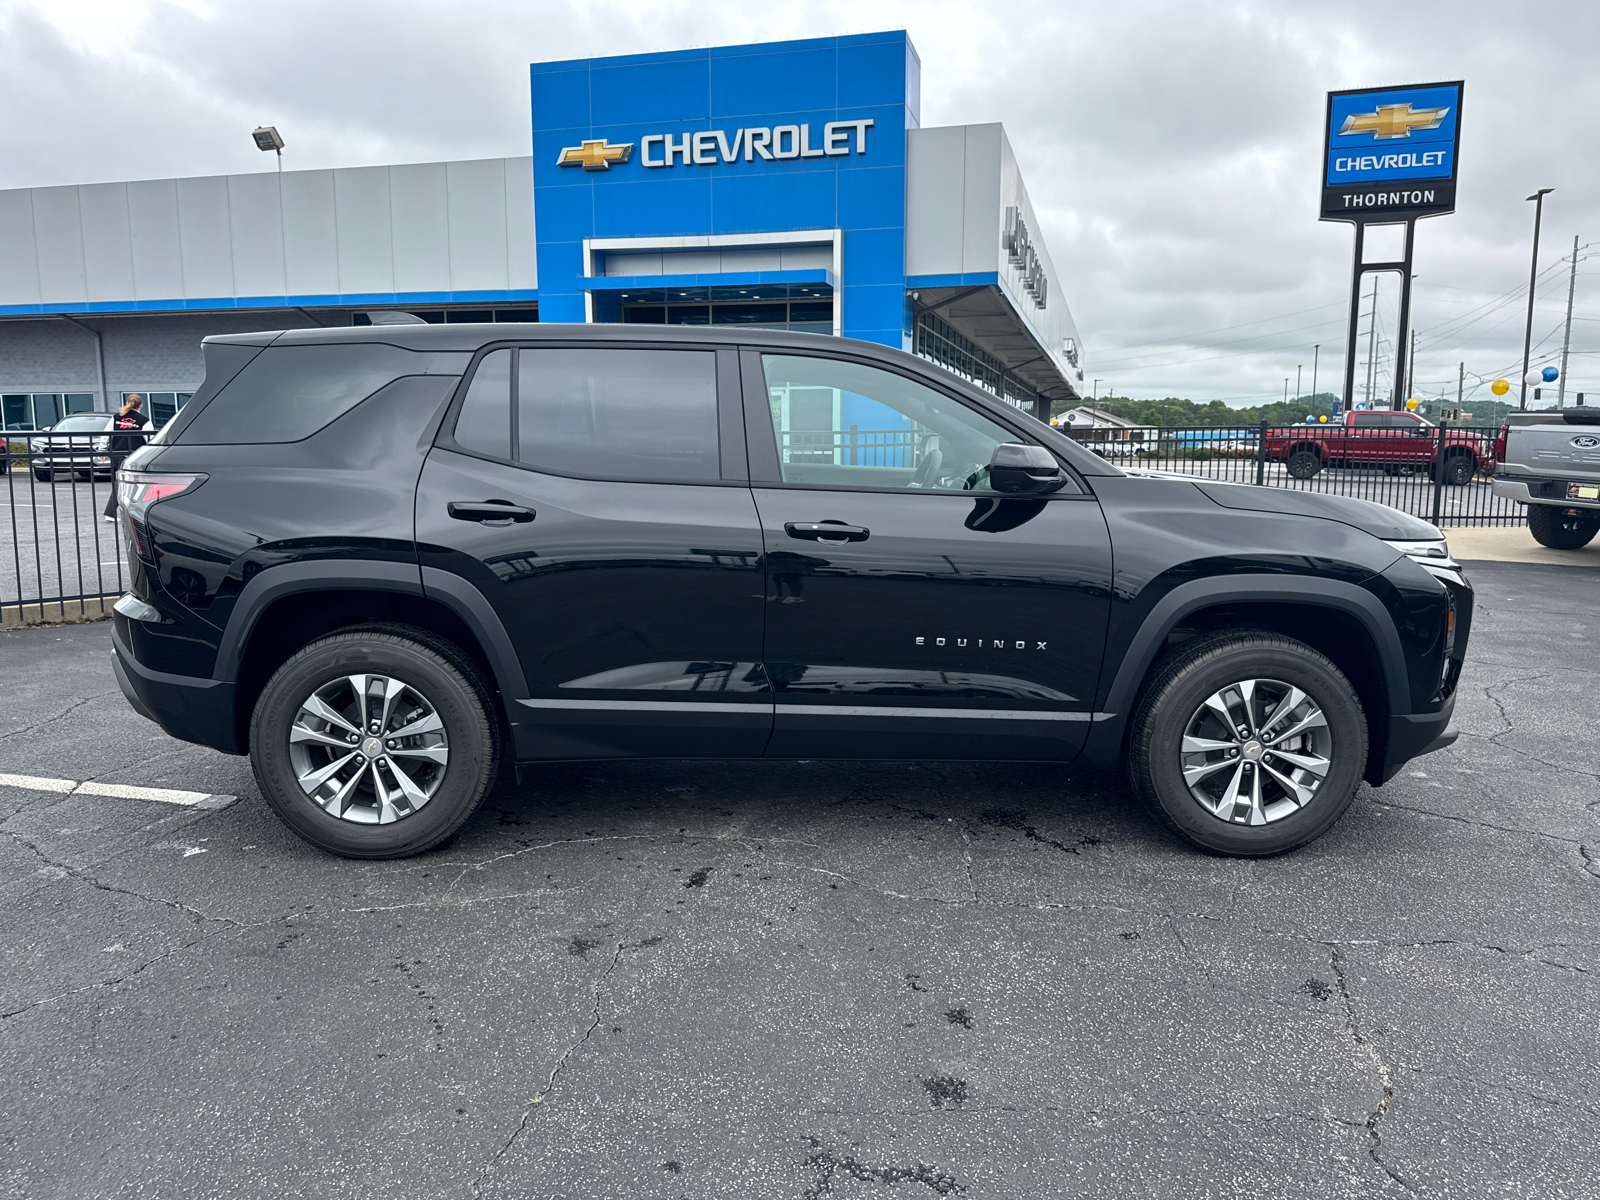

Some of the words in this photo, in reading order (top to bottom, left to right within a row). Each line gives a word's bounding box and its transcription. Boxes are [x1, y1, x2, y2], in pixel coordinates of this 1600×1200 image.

[641, 118, 874, 168] CHEVROLET
[1335, 151, 1447, 172] CHEVROLET
[1342, 190, 1435, 208] THORNTON
[915, 637, 1047, 651] EQUINOX
